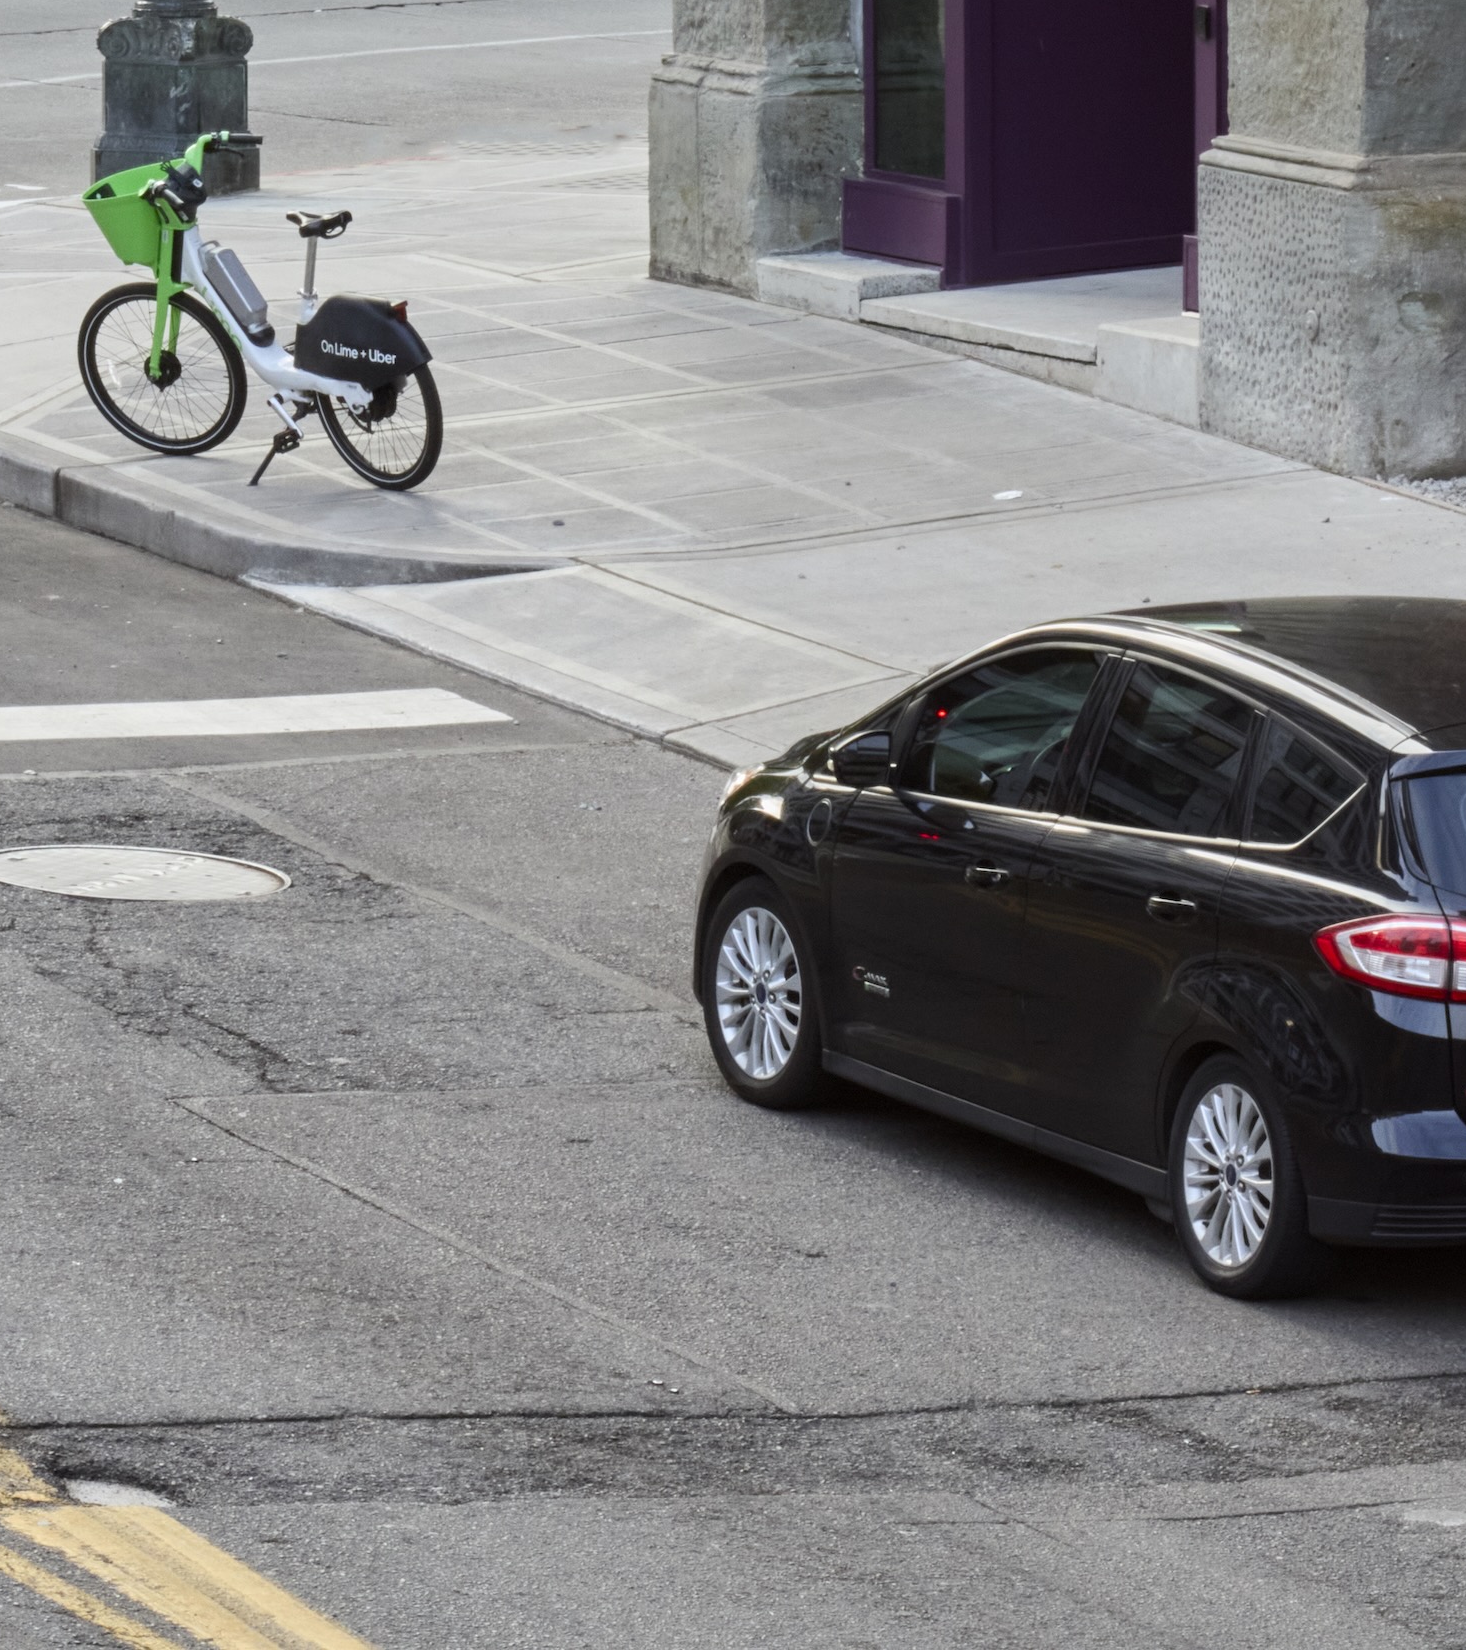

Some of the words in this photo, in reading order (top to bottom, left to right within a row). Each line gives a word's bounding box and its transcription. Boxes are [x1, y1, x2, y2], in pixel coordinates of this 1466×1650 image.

[320, 339, 334, 353] On
[334, 341, 359, 359] Lime
[368, 350, 397, 365] Uber
